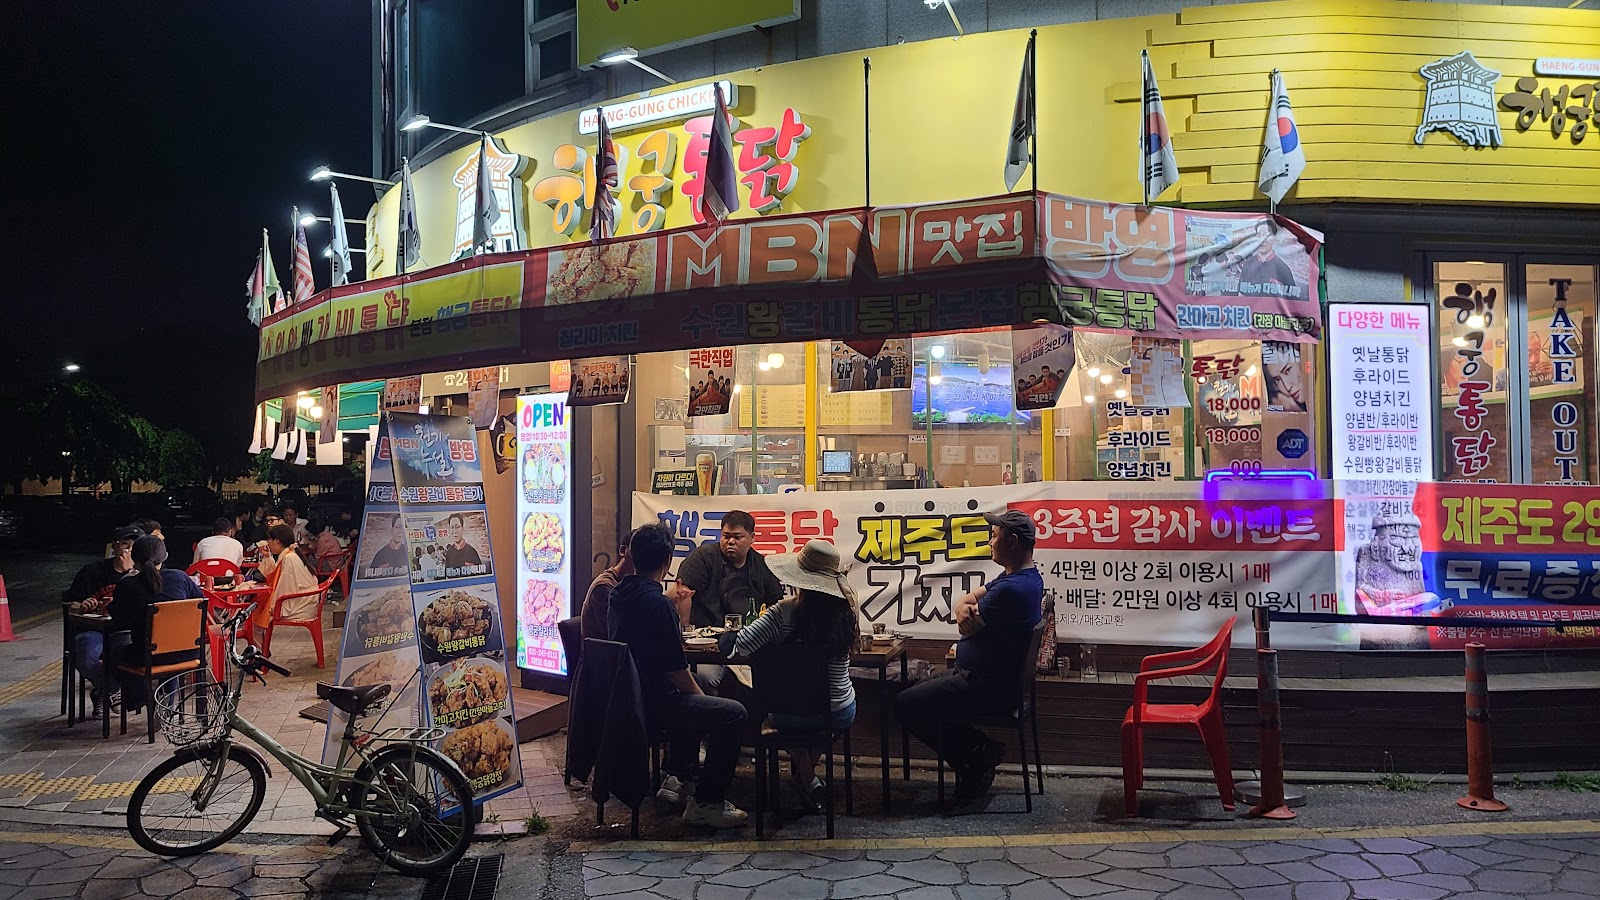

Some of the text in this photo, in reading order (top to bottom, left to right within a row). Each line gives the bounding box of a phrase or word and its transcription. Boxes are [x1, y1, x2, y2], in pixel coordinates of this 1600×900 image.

[667, 86, 728, 112] CHICKE
[1501, 77, 1600, 140] 행궁
[923, 210, 1023, 264] 맛집
[1046, 195, 1174, 285] 방영
[664, 209, 905, 296] MBN
[1176, 304, 1221, 330] 간마고
[1222, 306, 1252, 331] 치킨
[1338, 311, 1421, 330] 다양한 메뉴
[1548, 277, 1577, 384] TAKE
[1045, 331, 1073, 354] 것인가
[690, 349, 733, 369] 극한직업
[1352, 346, 1410, 364] 옛날통닭
[1352, 367, 1410, 385] 후라이드
[1443, 282, 1497, 476] 행궁통닭
[1206, 397, 1261, 412] 18,000
[1353, 390, 1411, 407] 양념치킨
[523, 402, 564, 428] OPEN
[1345, 412, 1419, 430] 양념반/후라이반
[393, 438, 419, 450] MBN
[1107, 430, 1171, 447] 후라이드
[1206, 429, 1261, 445] 18,000
[1281, 438, 1305, 450] ADT
[1347, 434, 1418, 451] 왕갈비반/후라이반
[1551, 401, 1579, 481] OUT
[448, 438, 476, 462] 방영
[1106, 460, 1172, 478] 양념치킨
[1343, 456, 1422, 474] 수원빵왕갈비통닭
[399, 485, 484, 503] 수원왕갈비통닭본가
[1034, 505, 1120, 544] 3주년
[1130, 505, 1202, 544] 감사
[1211, 505, 1321, 545] 이벤트
[1442, 496, 1554, 545] 제주도
[854, 512, 994, 566] 제주도
[1050, 560, 1097, 581] 4만원
[1102, 561, 1138, 582] 이상
[1143, 562, 1173, 582] 2회
[1178, 562, 1234, 583] 이용시
[1241, 562, 1271, 584] 1매
[1444, 560, 1600, 600] 무/료/증/
[1112, 589, 1160, 610] 2만원
[1166, 590, 1201, 611] 이상
[1207, 591, 1239, 612] 4회
[1245, 592, 1301, 612] 이용시
[1308, 592, 1337, 612] 1매
[436, 635, 486, 654] 수원왕갈비통닭
[433, 708, 469, 728] 간마고치킨
